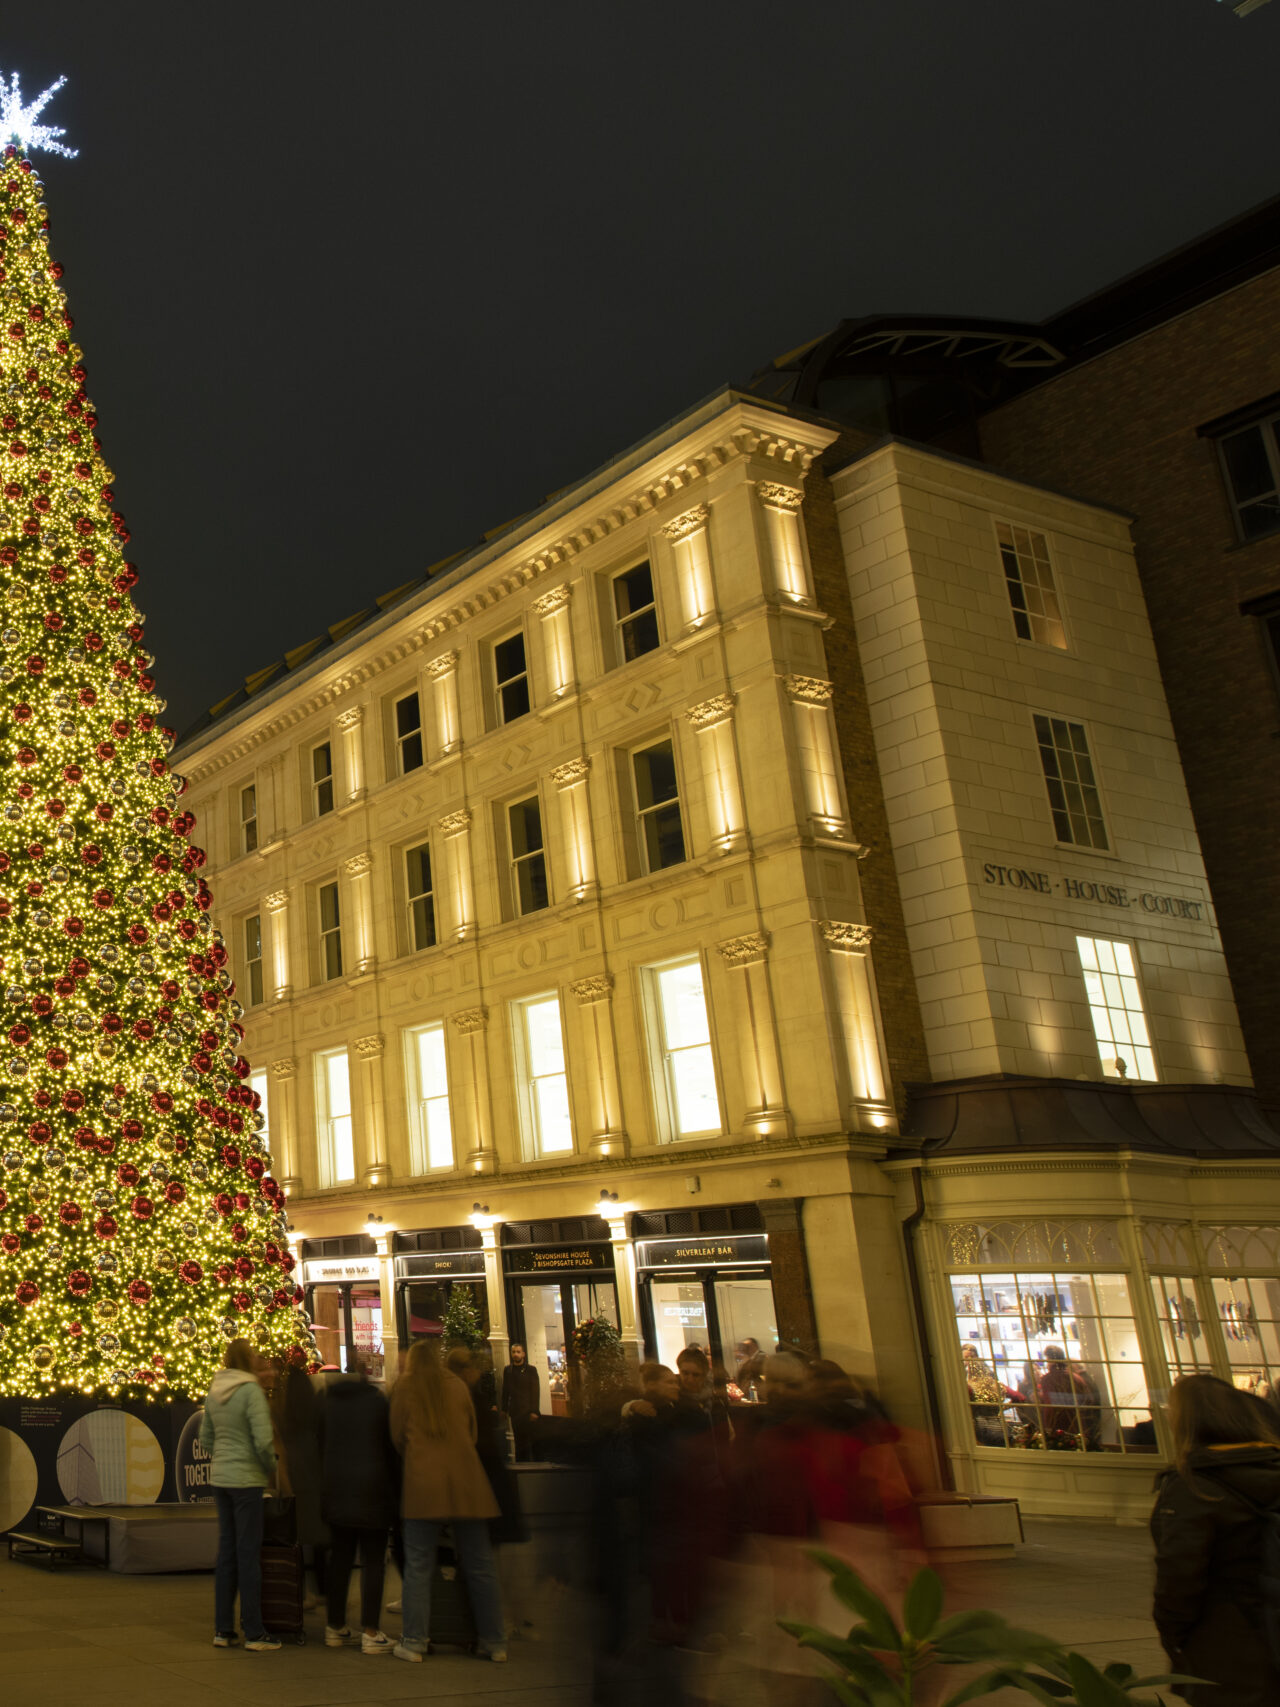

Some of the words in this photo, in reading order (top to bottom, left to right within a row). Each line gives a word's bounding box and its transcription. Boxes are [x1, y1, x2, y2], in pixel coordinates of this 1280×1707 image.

[984, 863, 1052, 894] STONE
[1064, 878, 1130, 908] HOUSE
[1142, 892, 1202, 921] COURT
[535, 1252, 569, 1260] DEVONSHIRE
[570, 1250, 590, 1259] HOUSE
[676, 1247, 715, 1257] SILVERLEAF
[718, 1246, 733, 1255] BAR
[537, 1259, 574, 1268] BISHOPSGATE
[575, 1258, 593, 1266] PLAZA
[355, 1320, 378, 1331] friends
